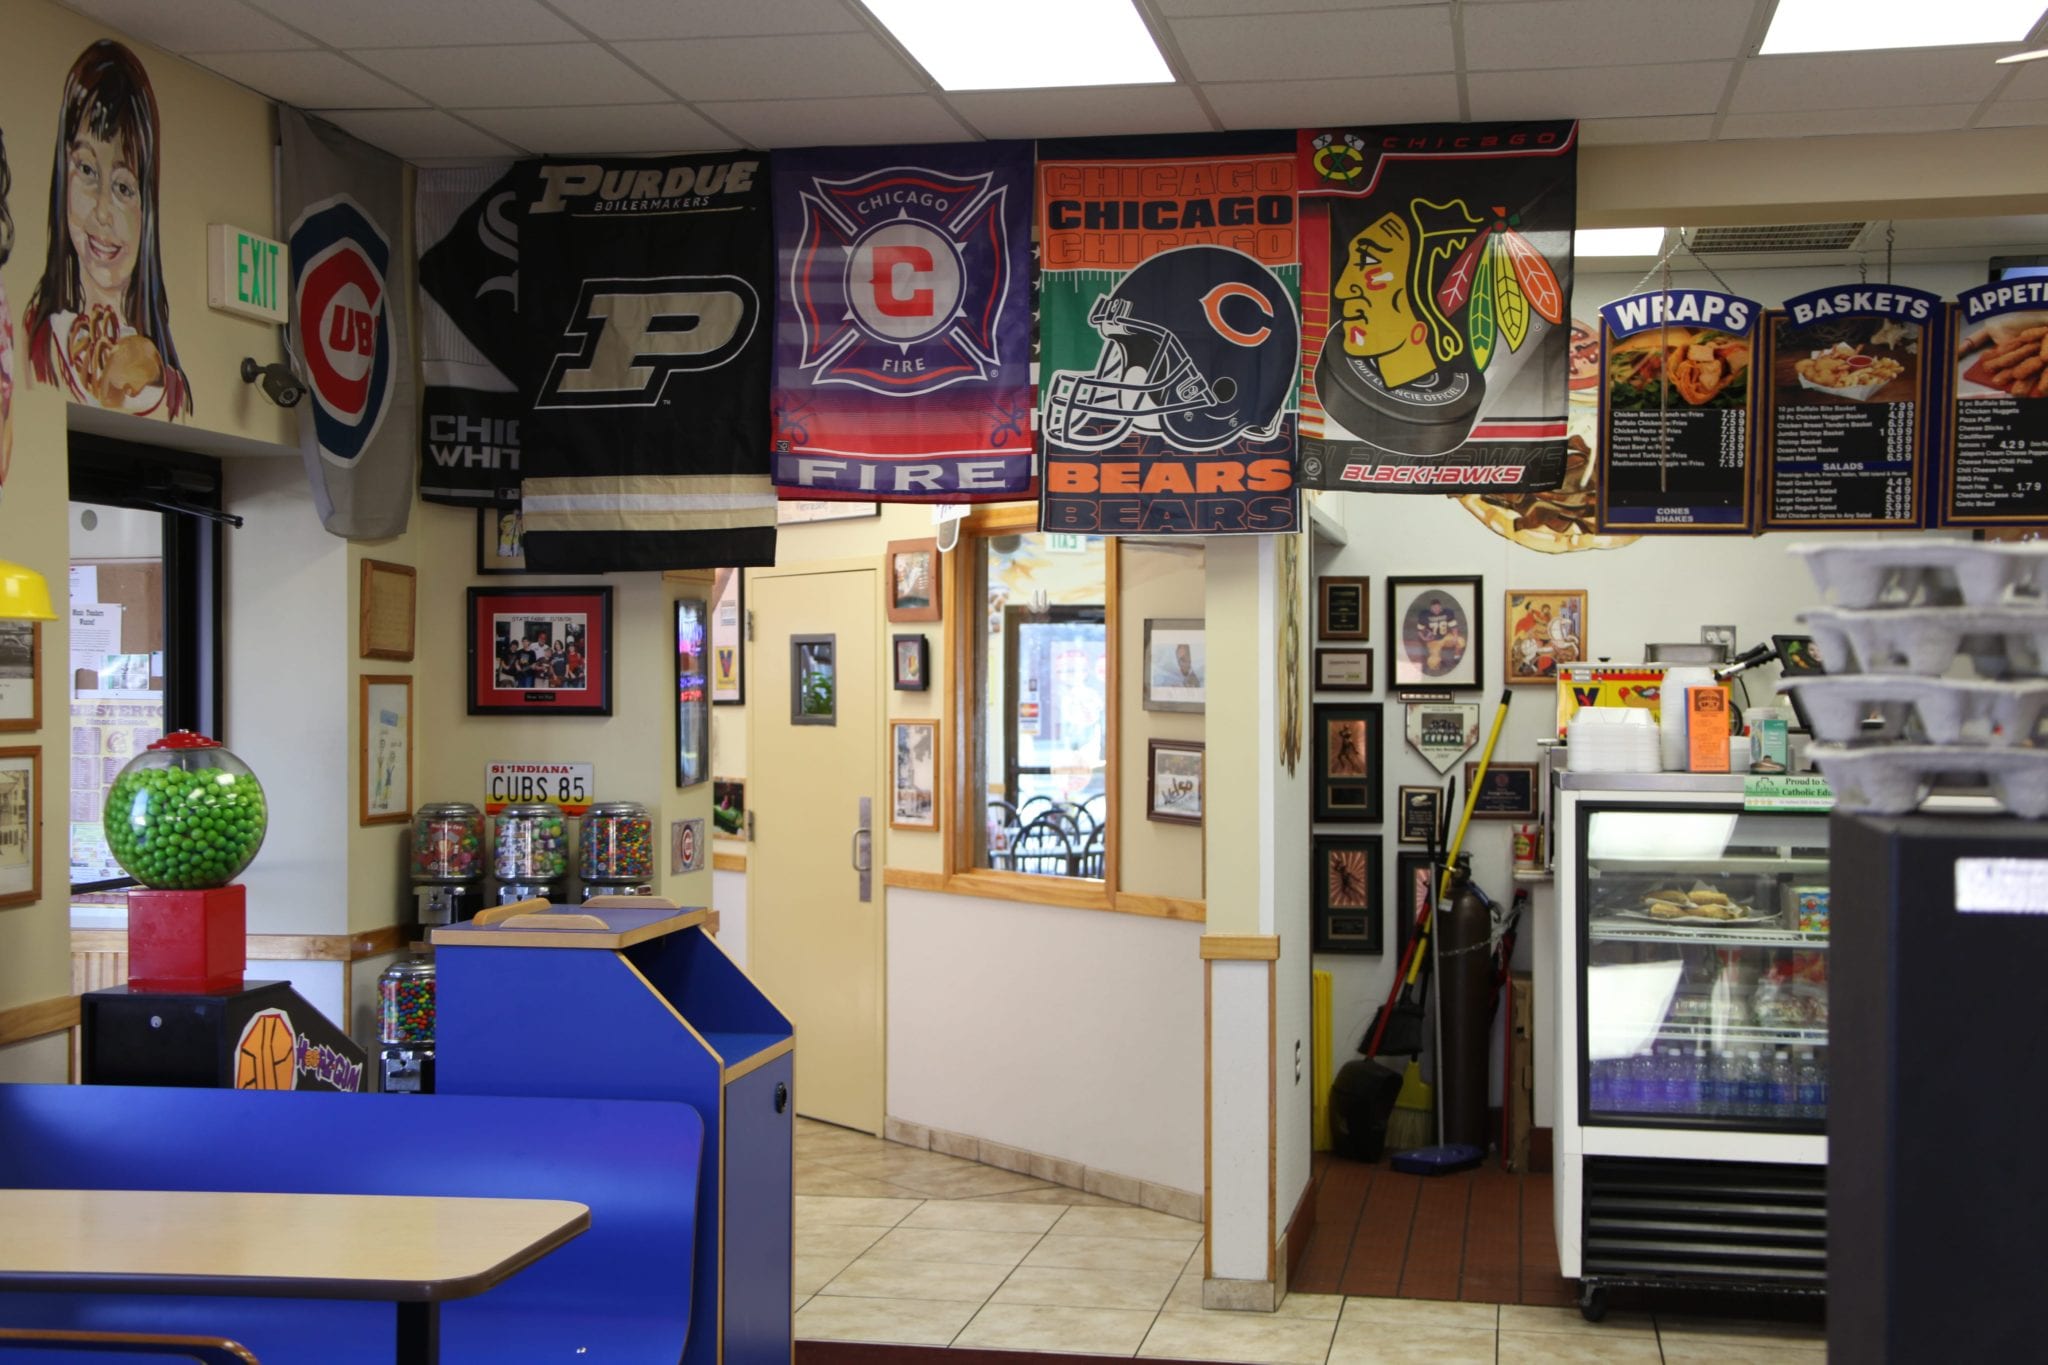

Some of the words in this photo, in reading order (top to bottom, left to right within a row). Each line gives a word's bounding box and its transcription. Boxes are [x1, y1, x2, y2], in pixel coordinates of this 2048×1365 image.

[1381, 132, 1557, 149] CHICAGO
[528, 161, 760, 214] PURDUE
[1046, 161, 1294, 197] CHICAGO
[594, 196, 710, 211] BOILERMAKERS
[857, 190, 949, 216] CHICAGO
[1049, 195, 1293, 230] CHICAGO
[236, 233, 279, 311] EXIT
[868, 245, 934, 317] C
[1615, 294, 1749, 332] WRAPS
[1793, 292, 1930, 324] BASKETS
[534, 274, 760, 410] P
[882, 358, 926, 373] FIRE
[797, 459, 1006, 491] FIRE
[1048, 459, 1292, 493] BEARS
[1340, 464, 1526, 484] BLACKHAWKS
[1658, 460, 1679, 468] Vggie
[1047, 497, 1293, 532] BEARS
[1655, 515, 1694, 523] SHAKES
[511, 765, 569, 774] INDIANA
[1785, 777, 1810, 785] Proud
[1812, 777, 1821, 785] to
[492, 775, 548, 803] CUBS
[559, 776, 585, 803] 85
[1782, 788, 1815, 796] Catholic
